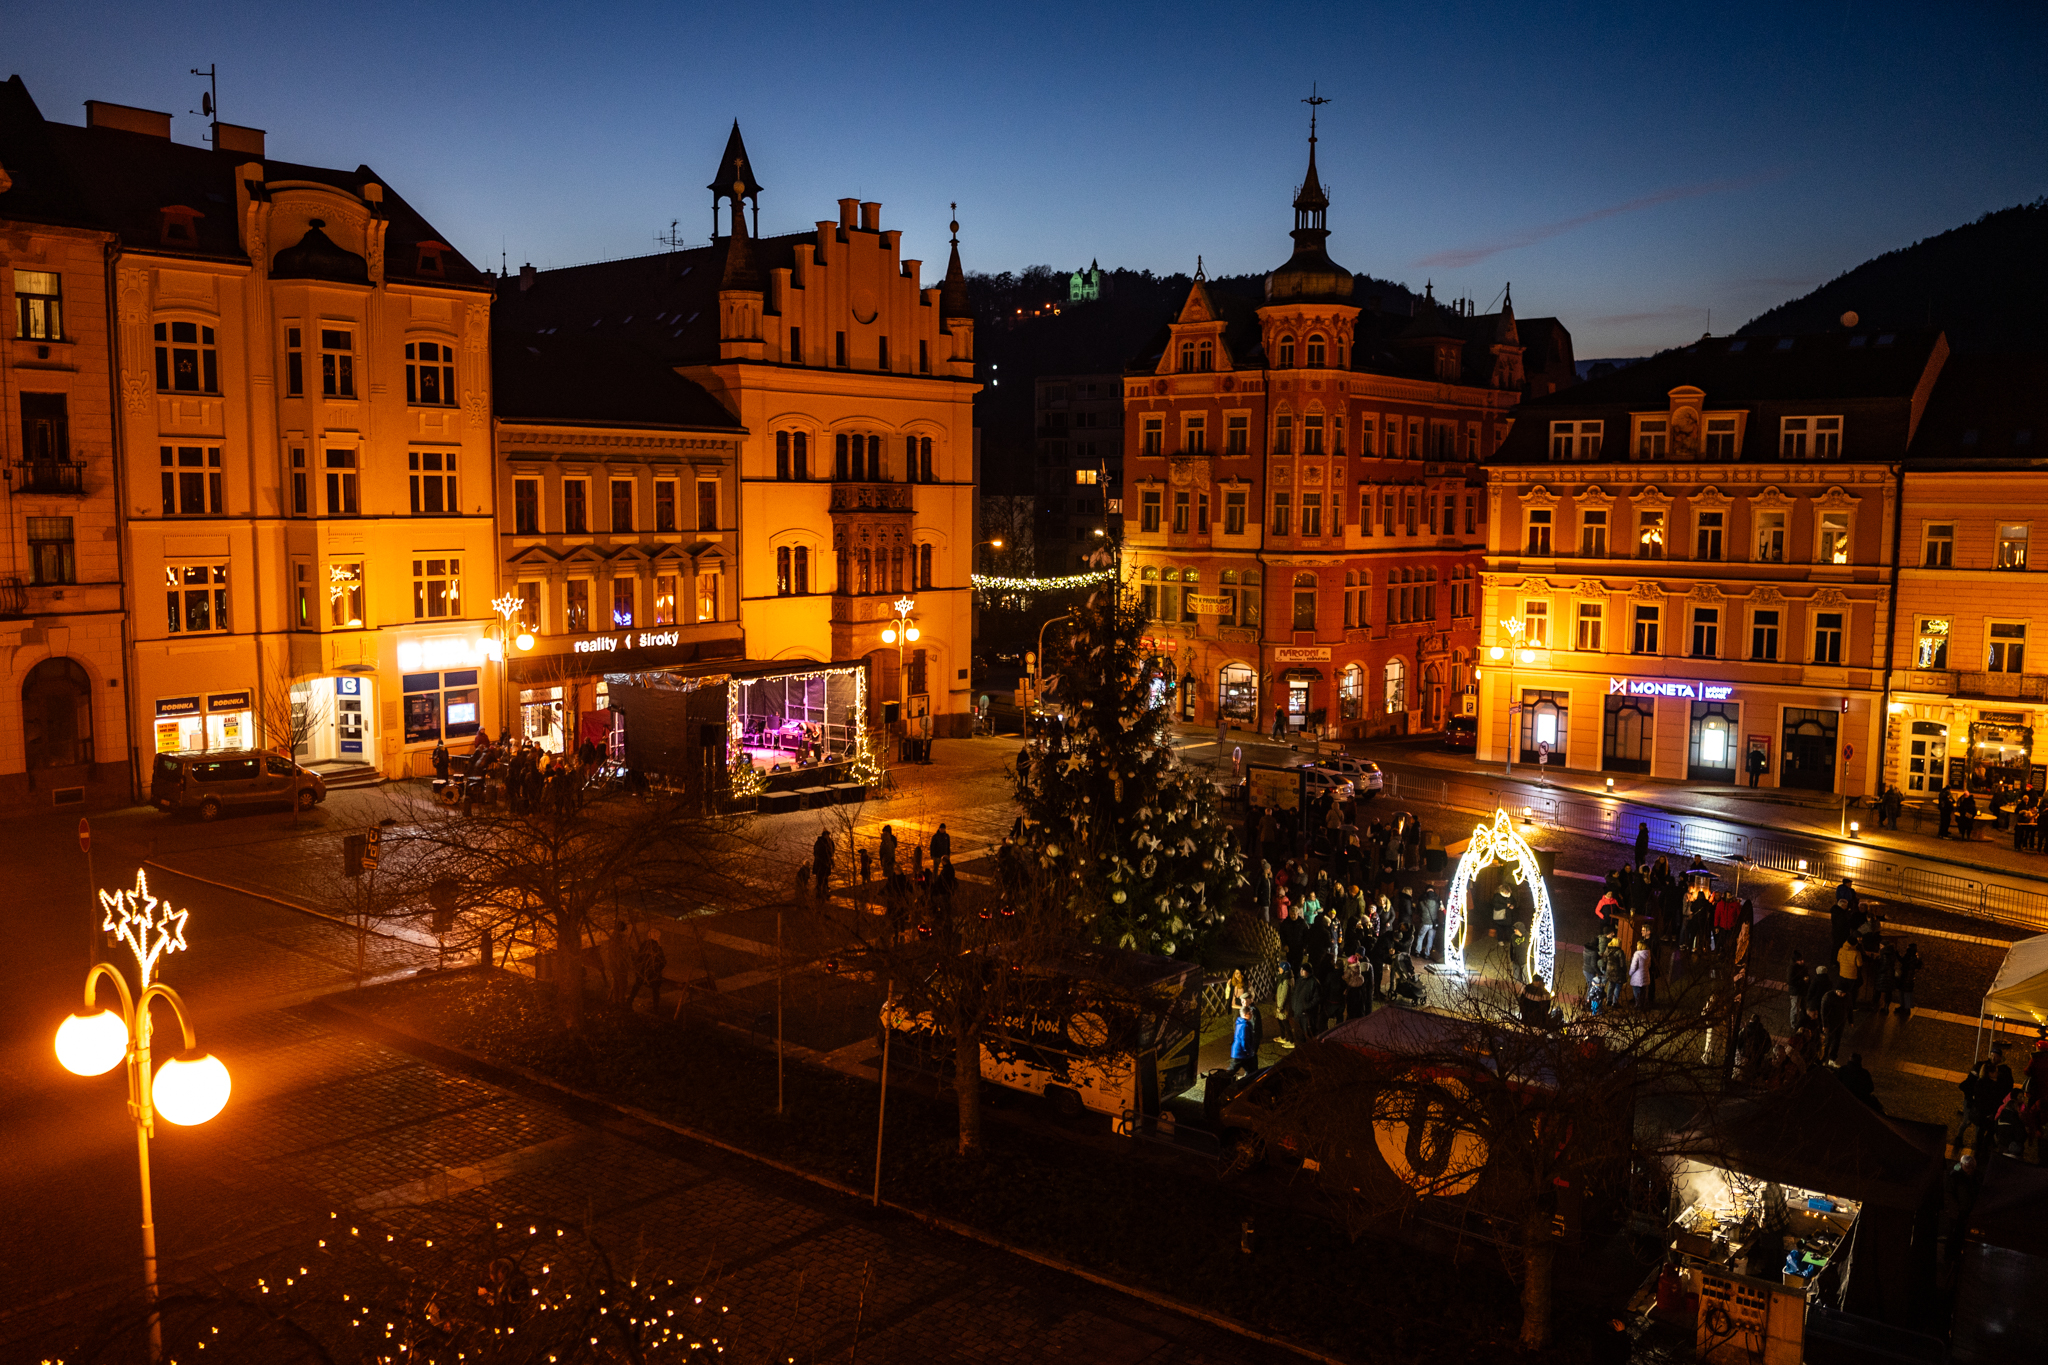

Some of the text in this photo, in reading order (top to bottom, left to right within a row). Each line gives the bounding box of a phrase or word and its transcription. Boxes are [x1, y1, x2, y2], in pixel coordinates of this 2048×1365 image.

[1200, 604, 1213, 612] 310
[574, 631, 679, 653] reality široký
[1279, 649, 1320, 658] NÁRODNÍ
[1630, 681, 1733, 698] MONETA MONEY
[161, 702, 194, 711] RODINKA
[213, 698, 244, 707] RODINKA
[1030, 1012, 1060, 1036] food
